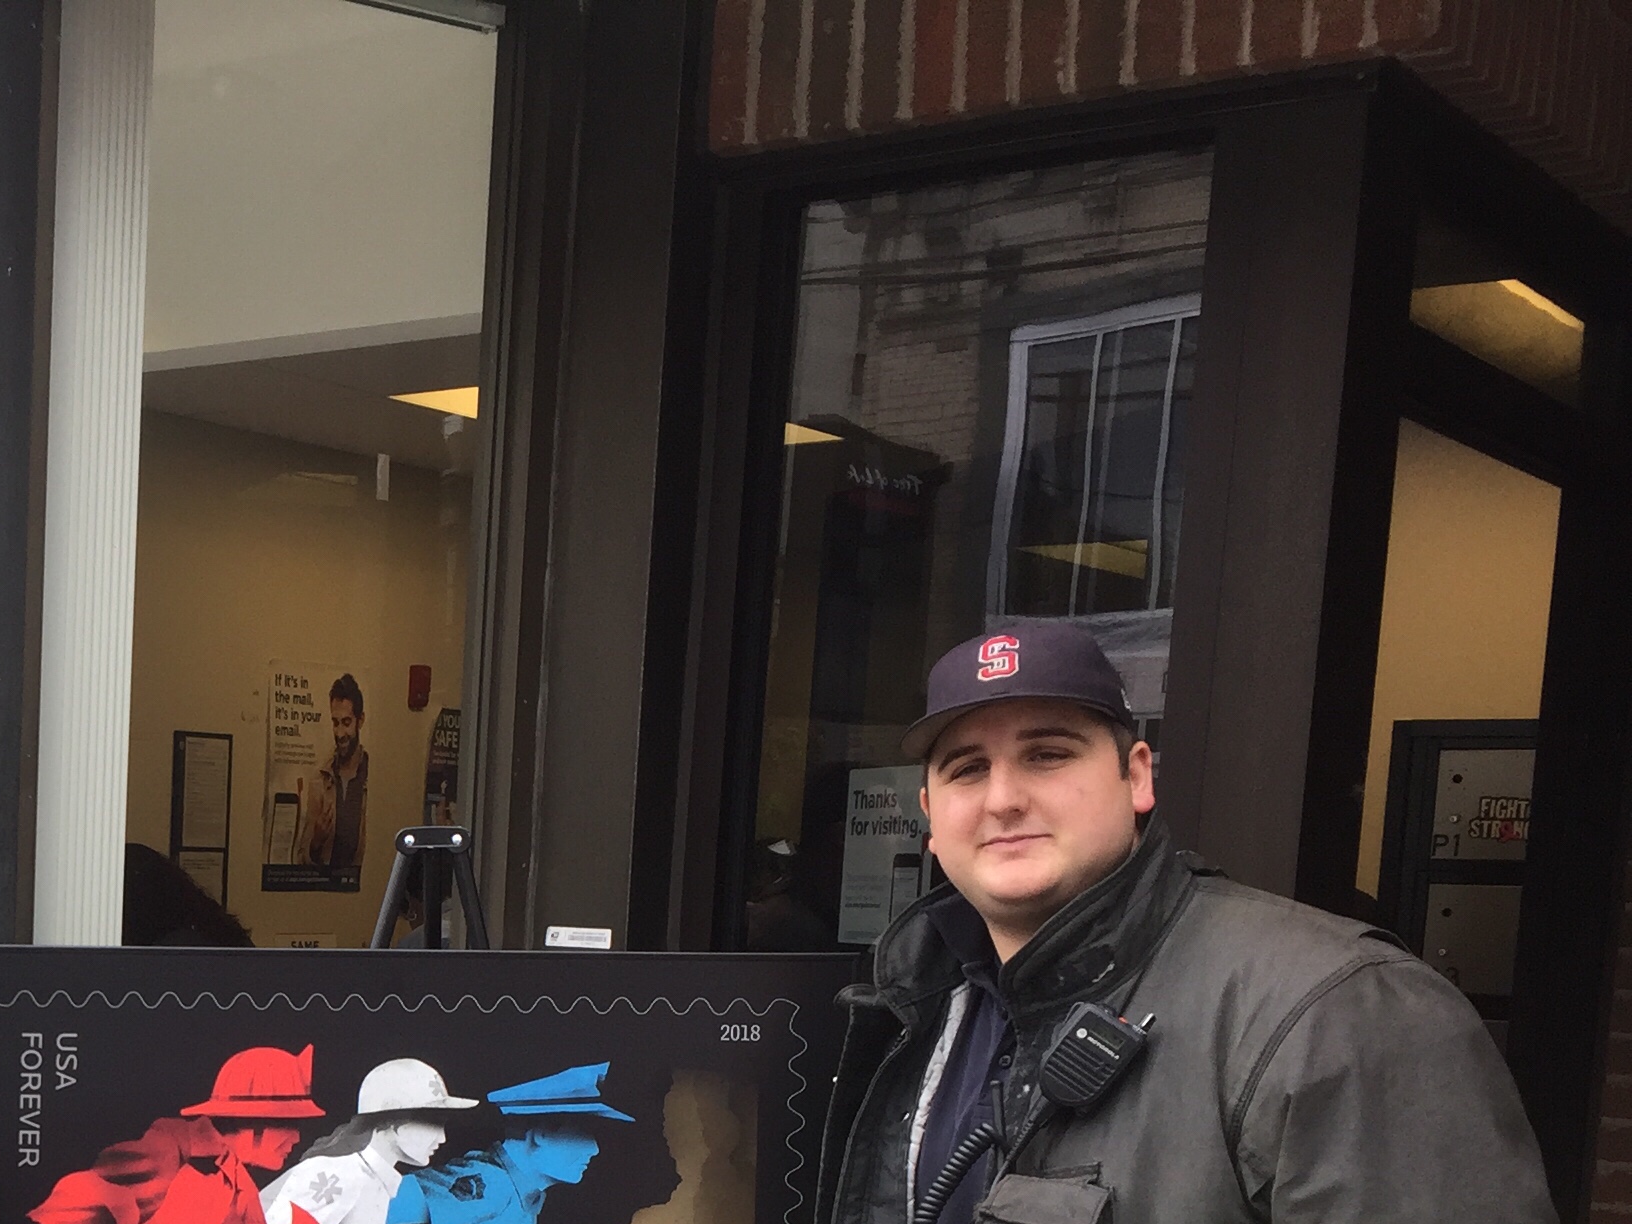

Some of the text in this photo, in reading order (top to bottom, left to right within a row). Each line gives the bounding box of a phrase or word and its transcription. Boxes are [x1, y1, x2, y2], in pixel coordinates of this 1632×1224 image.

[300, 676, 308, 689] in
[275, 690, 290, 704] the
[275, 706, 322, 724] it's in your
[434, 729, 458, 748] SAFE
[854, 789, 898, 810] Thanks
[851, 816, 922, 838] for visiting.
[1432, 834, 1461, 857] P1
[720, 1024, 761, 1042] 2018
[55, 1032, 78, 1090] USA
[18, 1032, 43, 1168] FOREVER
